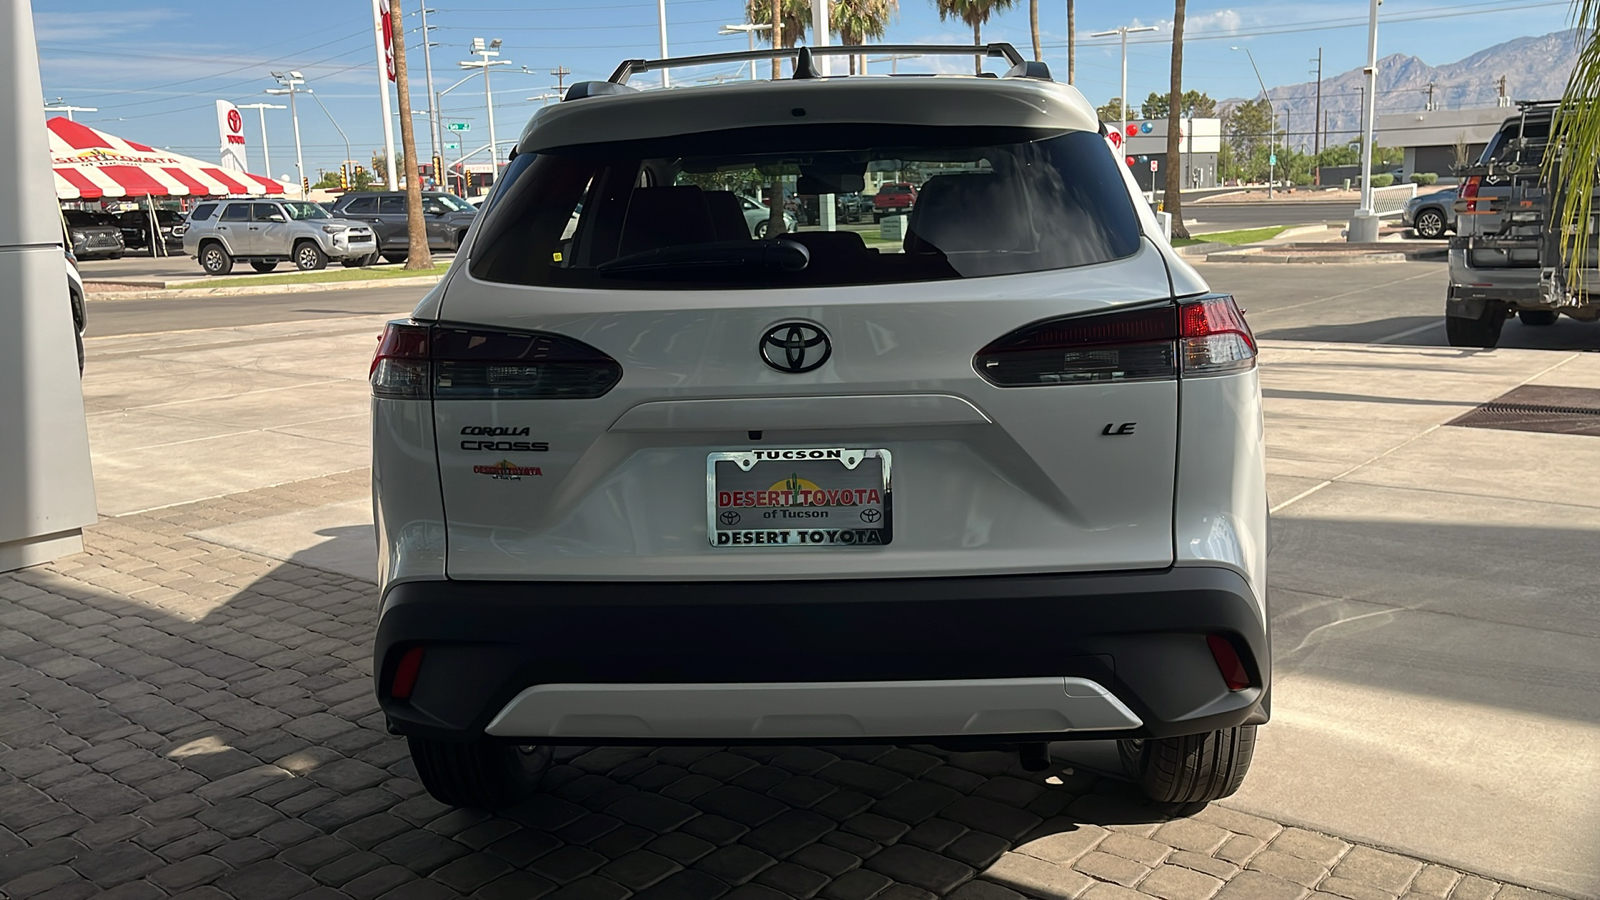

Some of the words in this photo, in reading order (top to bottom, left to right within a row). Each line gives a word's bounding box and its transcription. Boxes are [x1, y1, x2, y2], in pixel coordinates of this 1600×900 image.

[460, 426, 530, 436] COROLLA
[1102, 422, 1137, 435] LE
[460, 441, 549, 452] CROSS
[754, 450, 841, 459] TUCSON
[719, 491, 793, 507] DESERT
[799, 489, 881, 506] TOYOTA
[763, 509, 778, 519] of
[780, 509, 829, 518] Tucson
[717, 532, 791, 545] DESERT
[797, 531, 881, 544] TOYOTA
